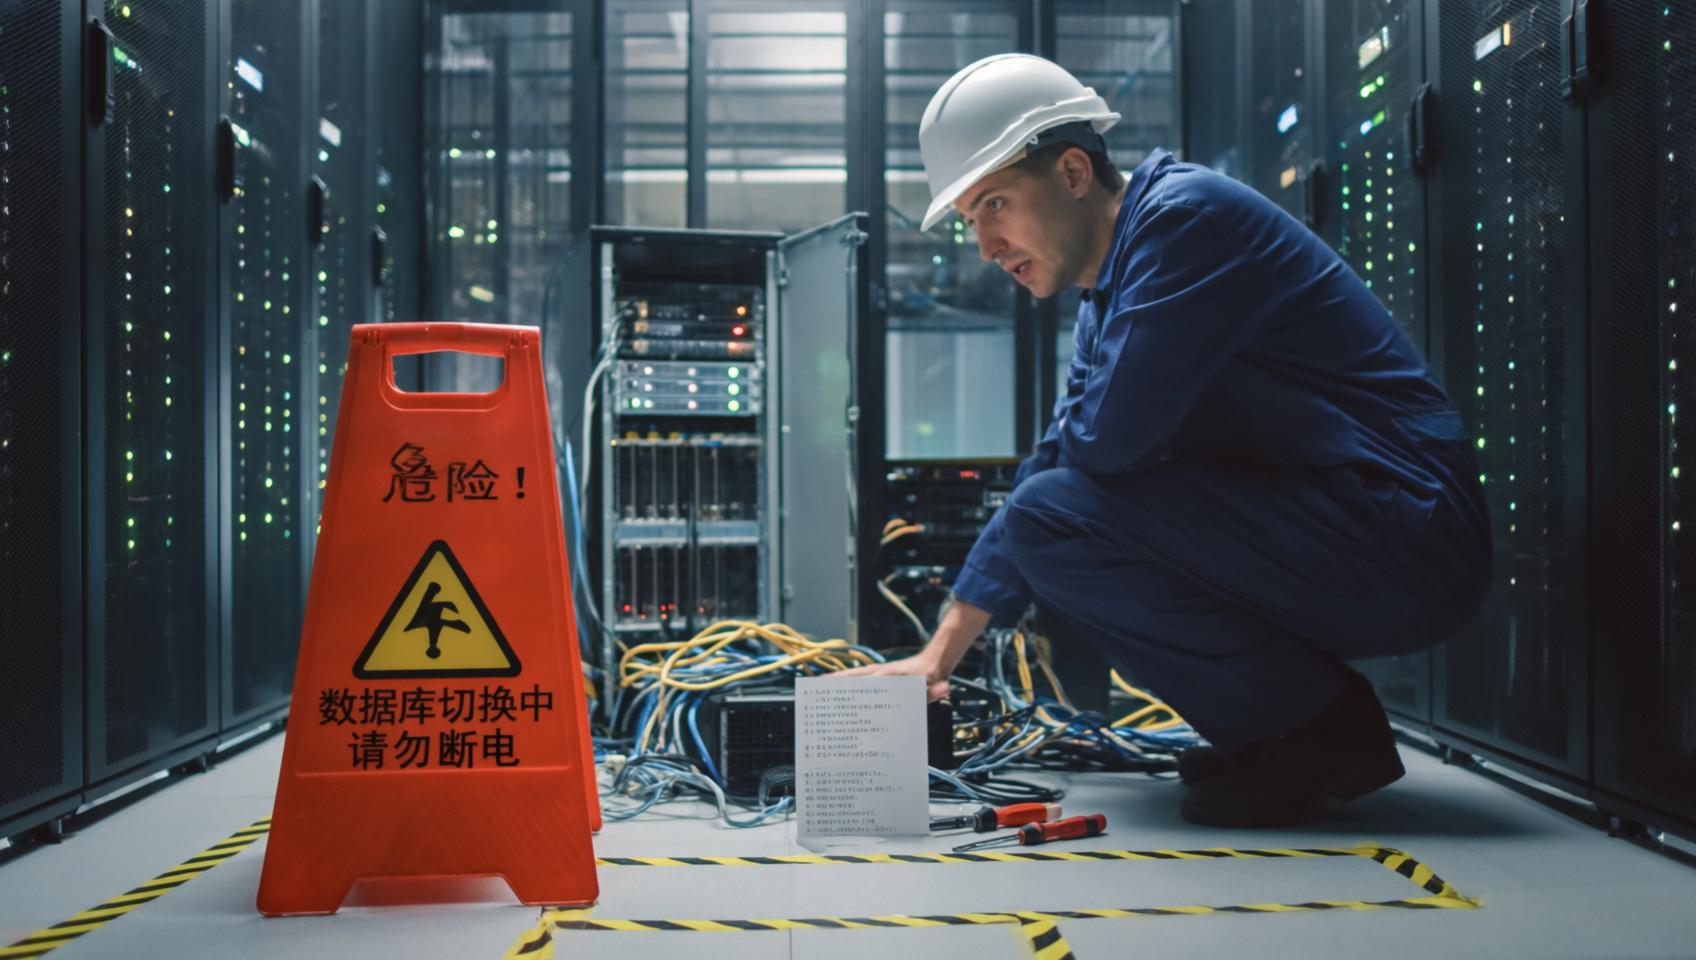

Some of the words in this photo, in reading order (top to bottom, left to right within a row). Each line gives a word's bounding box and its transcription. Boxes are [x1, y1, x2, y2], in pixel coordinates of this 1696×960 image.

[319, 684, 553, 726] 数据库切换中
[348, 728, 520, 770] 请勿断电
